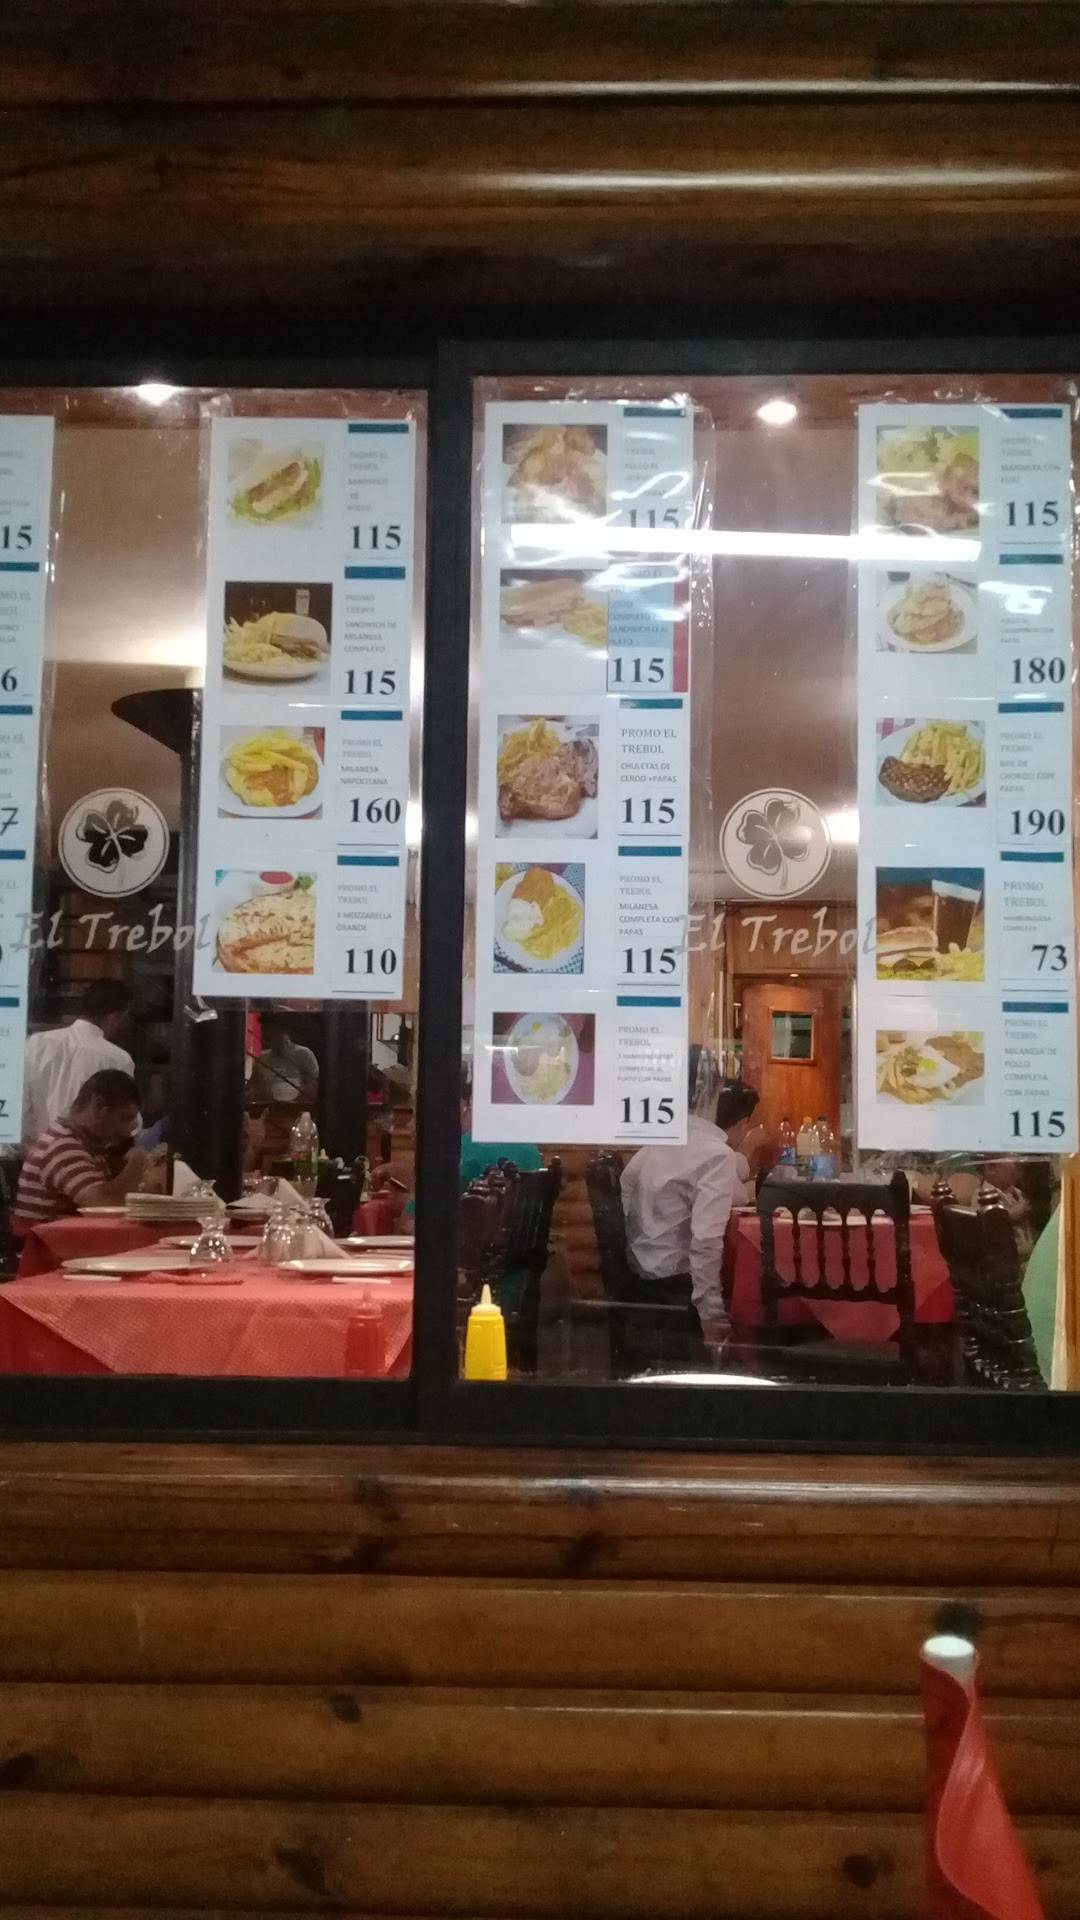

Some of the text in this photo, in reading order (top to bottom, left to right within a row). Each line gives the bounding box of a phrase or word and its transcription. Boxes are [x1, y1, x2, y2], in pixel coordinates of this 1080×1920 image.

[1005, 499, 1059, 527] 115
[351, 524, 402, 550] 115
[343, 668, 396, 696] 115
[608, 657, 665, 684] 115
[1011, 656, 1065, 684] 180
[621, 728, 677, 738] PROMO EL
[621, 744, 664, 754] TREBOL
[349, 797, 402, 824] 160
[621, 797, 676, 824] 115
[1010, 809, 1066, 836] 190
[9, 903, 211, 954] El Trebol
[674, 906, 877, 957] El Trebol
[344, 947, 397, 975] 110
[621, 947, 677, 975] 115
[1031, 944, 1068, 972] 73
[620, 1096, 674, 1125] 115
[1009, 1109, 1066, 1138] 115
